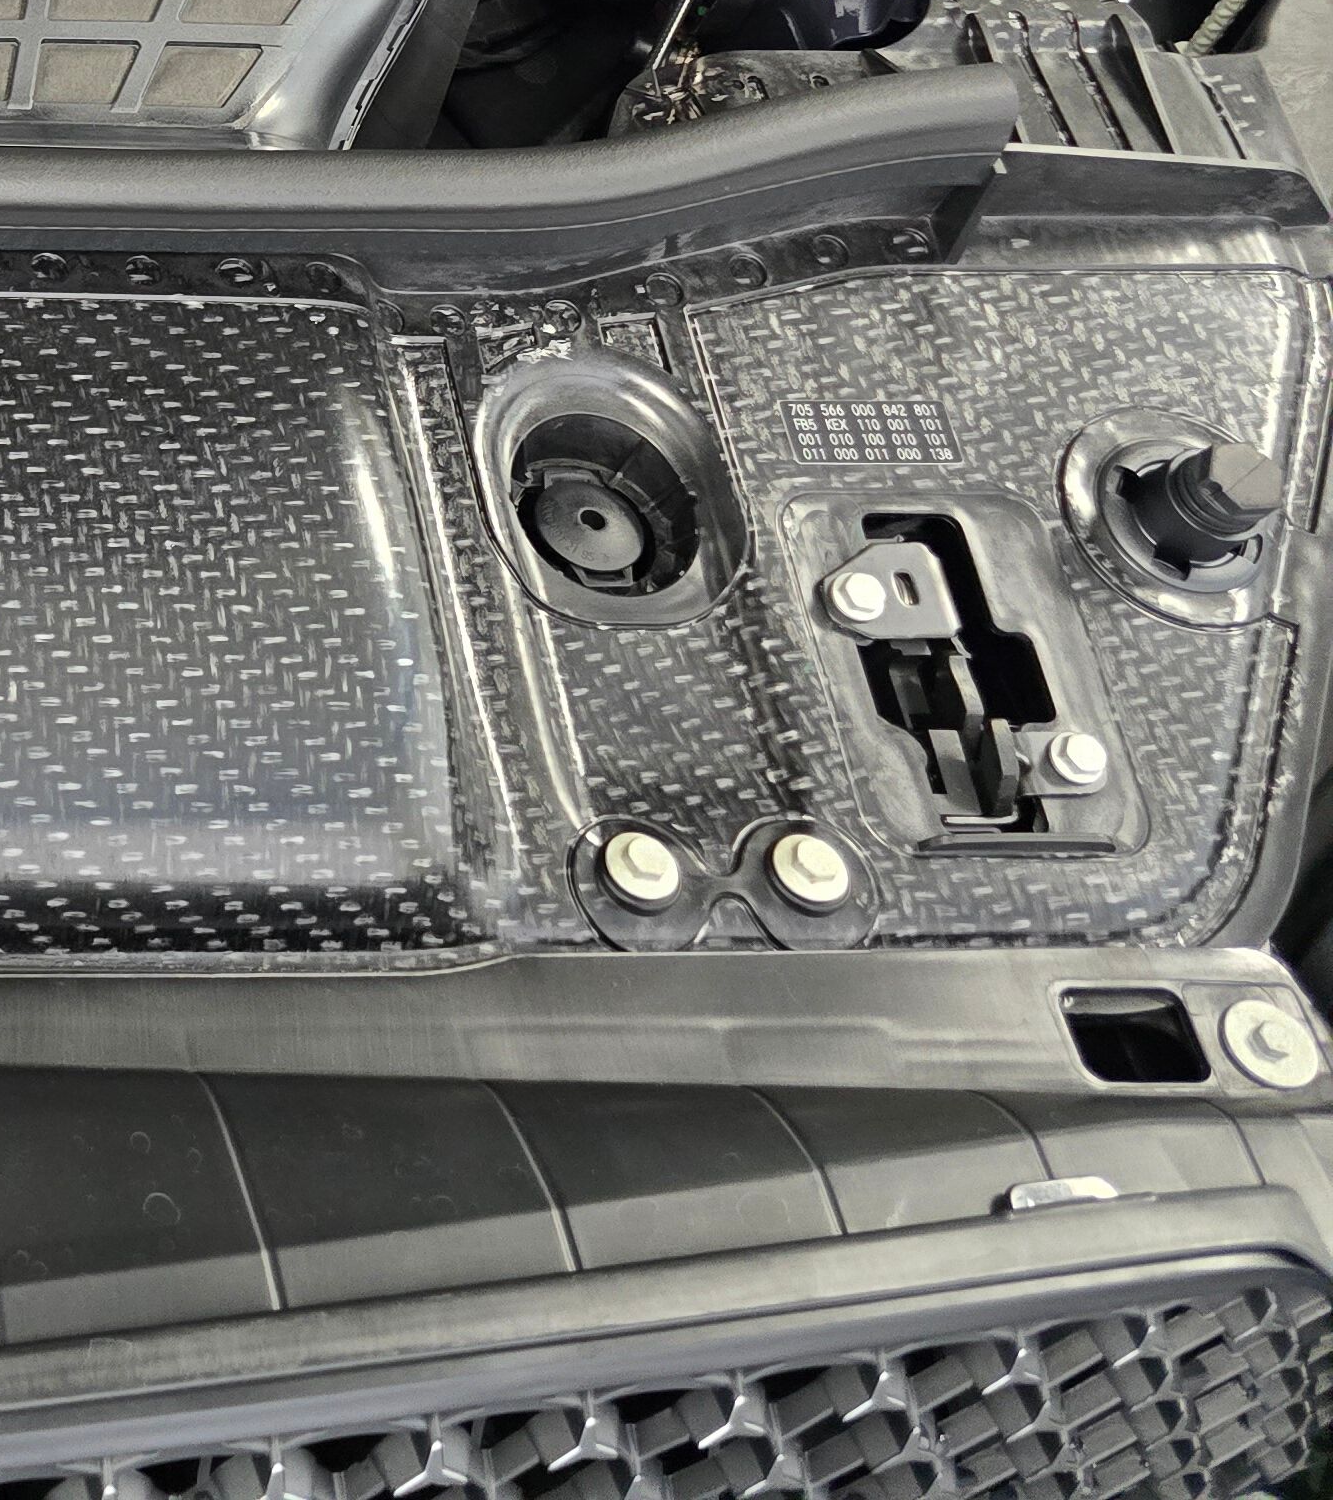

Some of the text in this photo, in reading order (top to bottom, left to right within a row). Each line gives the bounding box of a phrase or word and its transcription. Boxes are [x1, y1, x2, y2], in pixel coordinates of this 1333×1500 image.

[788, 404, 937, 416] 705 566 000 842 801
[825, 418, 849, 431] KEX
[857, 418, 881, 431] 110
[887, 418, 911, 431] 001
[920, 418, 943, 431] 101
[798, 433, 947, 446] 001 010 100 010 101
[803, 448, 953, 461] 011 000 011 000 138
